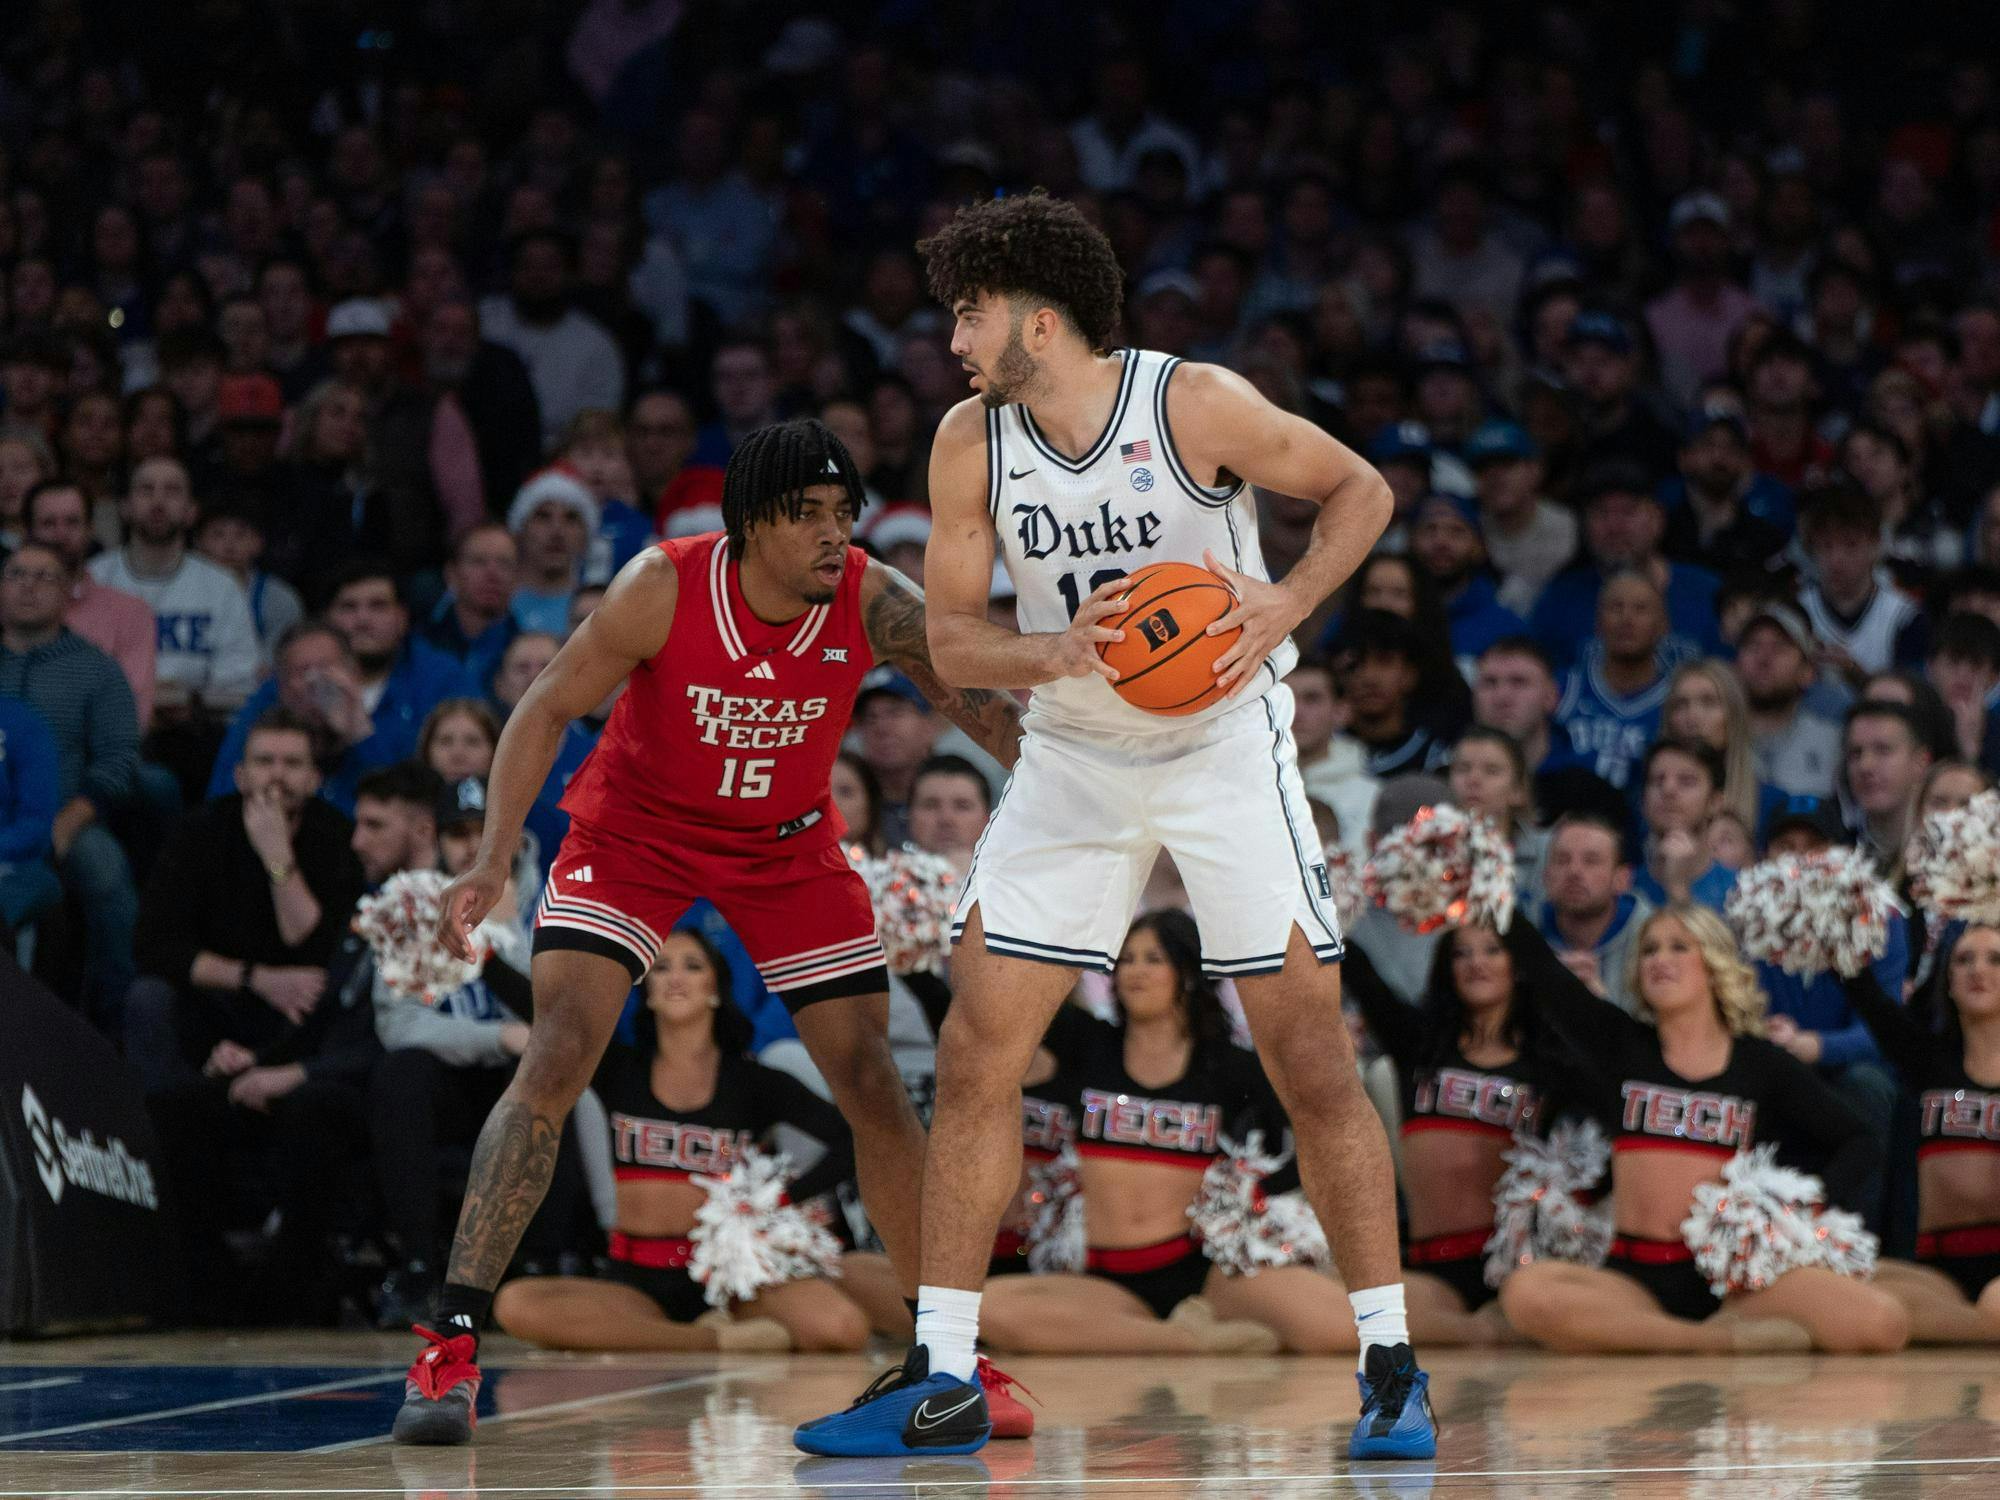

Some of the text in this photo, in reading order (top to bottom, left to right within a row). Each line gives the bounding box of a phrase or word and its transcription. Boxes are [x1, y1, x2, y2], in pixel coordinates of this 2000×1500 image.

[1012, 500, 1162, 560] Duke
[155, 613, 212, 652] KE
[822, 648, 848, 663] XII
[686, 684, 829, 722] TEXAS
[695, 714, 809, 749] TECH
[717, 758, 776, 799] 15
[1022, 1095, 1075, 1151] CH
[1080, 1087, 1223, 1153] TECH
[1413, 1066, 1544, 1136] TECH
[1621, 1079, 1760, 1153] TECH
[611, 1110, 754, 1173] TECH
